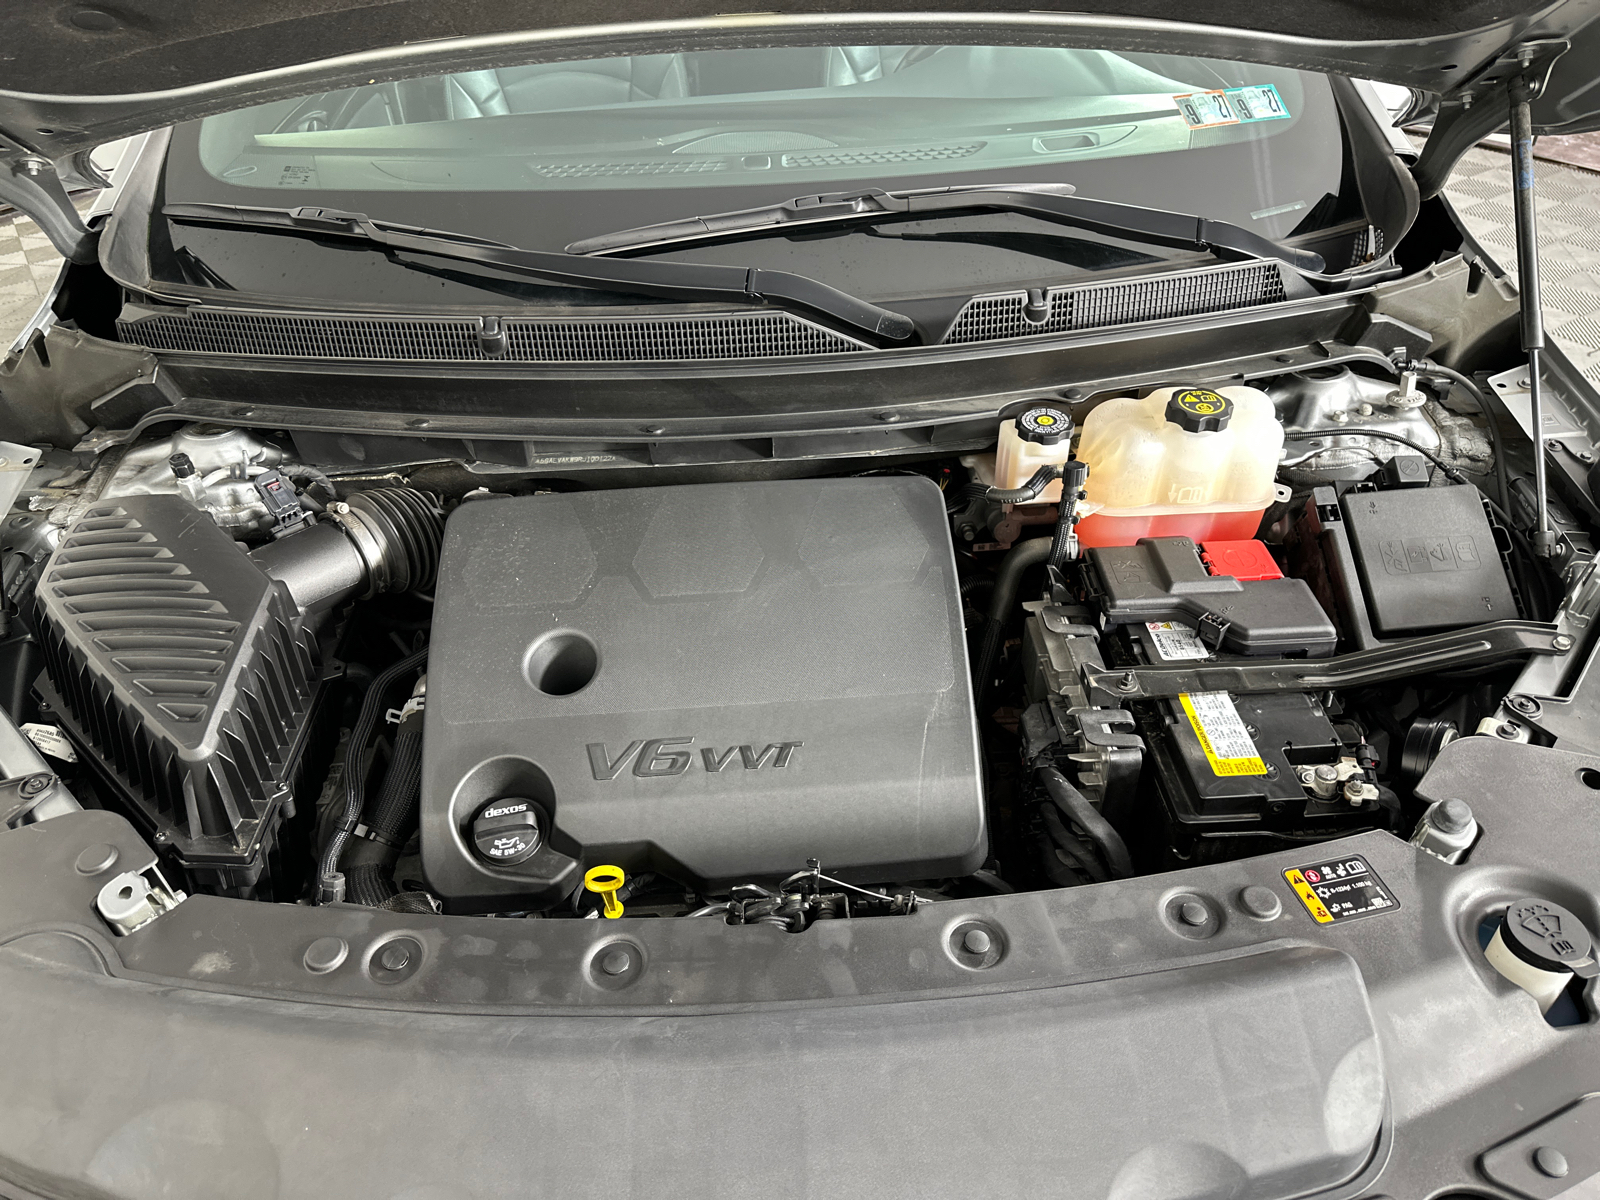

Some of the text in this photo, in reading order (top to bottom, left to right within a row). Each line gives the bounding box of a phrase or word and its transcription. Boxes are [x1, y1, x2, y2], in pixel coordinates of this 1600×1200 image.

[1212, 95, 1231, 118] 27
[1262, 90, 1281, 112] 27
[1191, 715, 1212, 750] DANGER POISON
[585, 736, 804, 781] V6 VVT
[484, 803, 528, 818] dexos
[489, 842, 526, 856] SAE 5W-30
